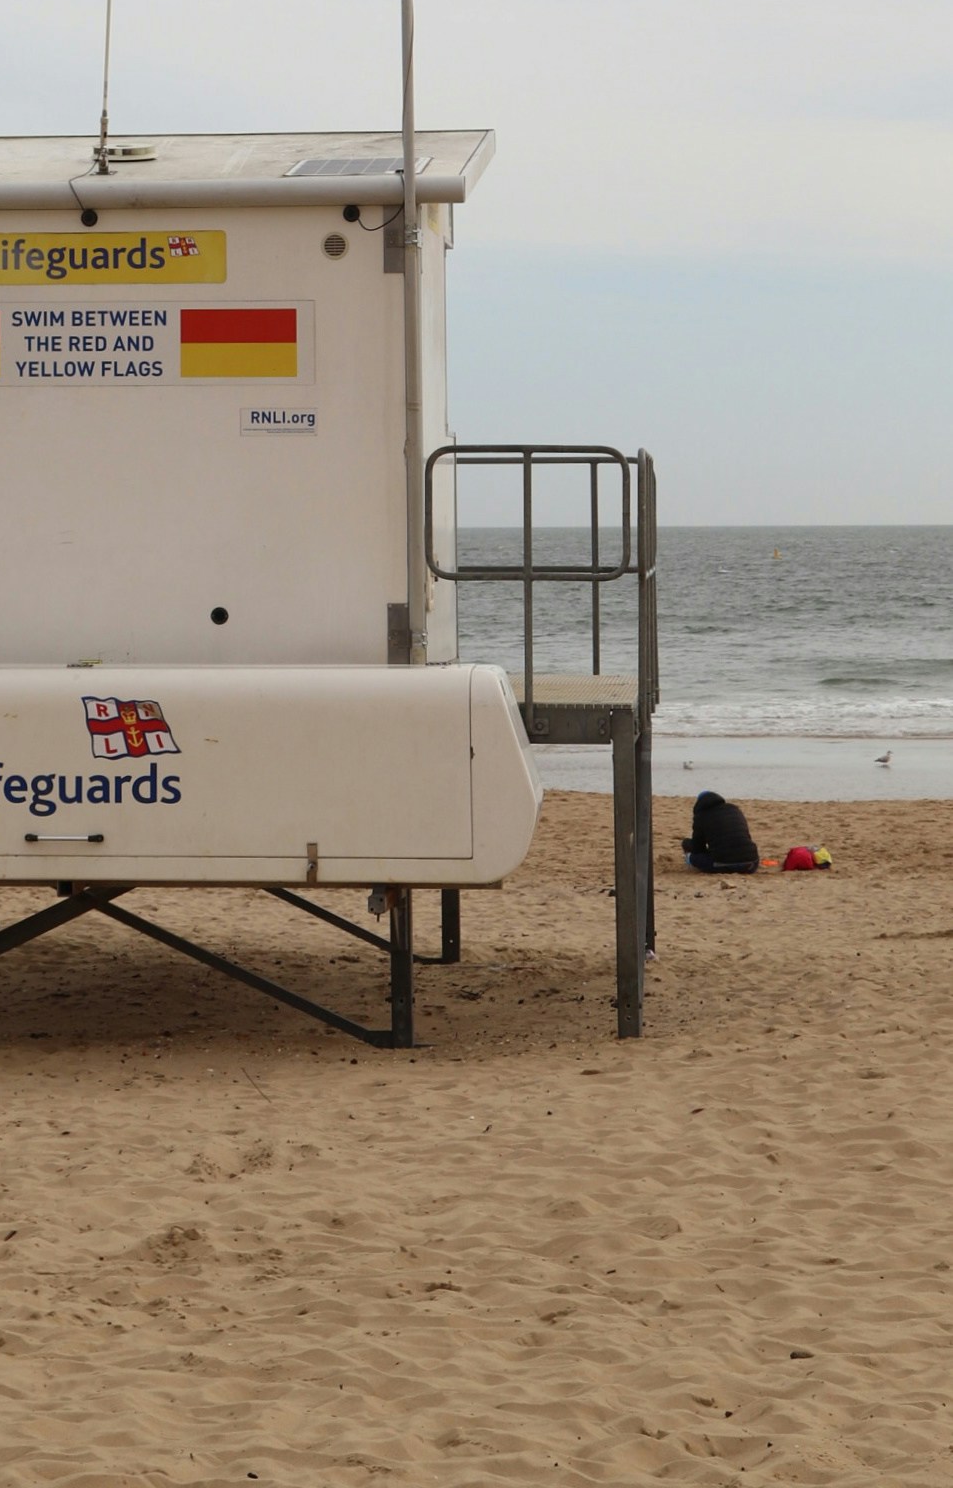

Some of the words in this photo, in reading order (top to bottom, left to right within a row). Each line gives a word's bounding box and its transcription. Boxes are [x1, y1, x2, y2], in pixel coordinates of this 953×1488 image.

[11, 311, 64, 326] SWIM
[72, 311, 167, 326] BETWEEN
[24, 336, 61, 351] THE
[69, 336, 106, 351] RED
[113, 336, 153, 351] AND
[16, 362, 95, 377] YELLOW
[102, 361, 162, 376] FLAGS
[250, 411, 316, 426] RNLI.org
